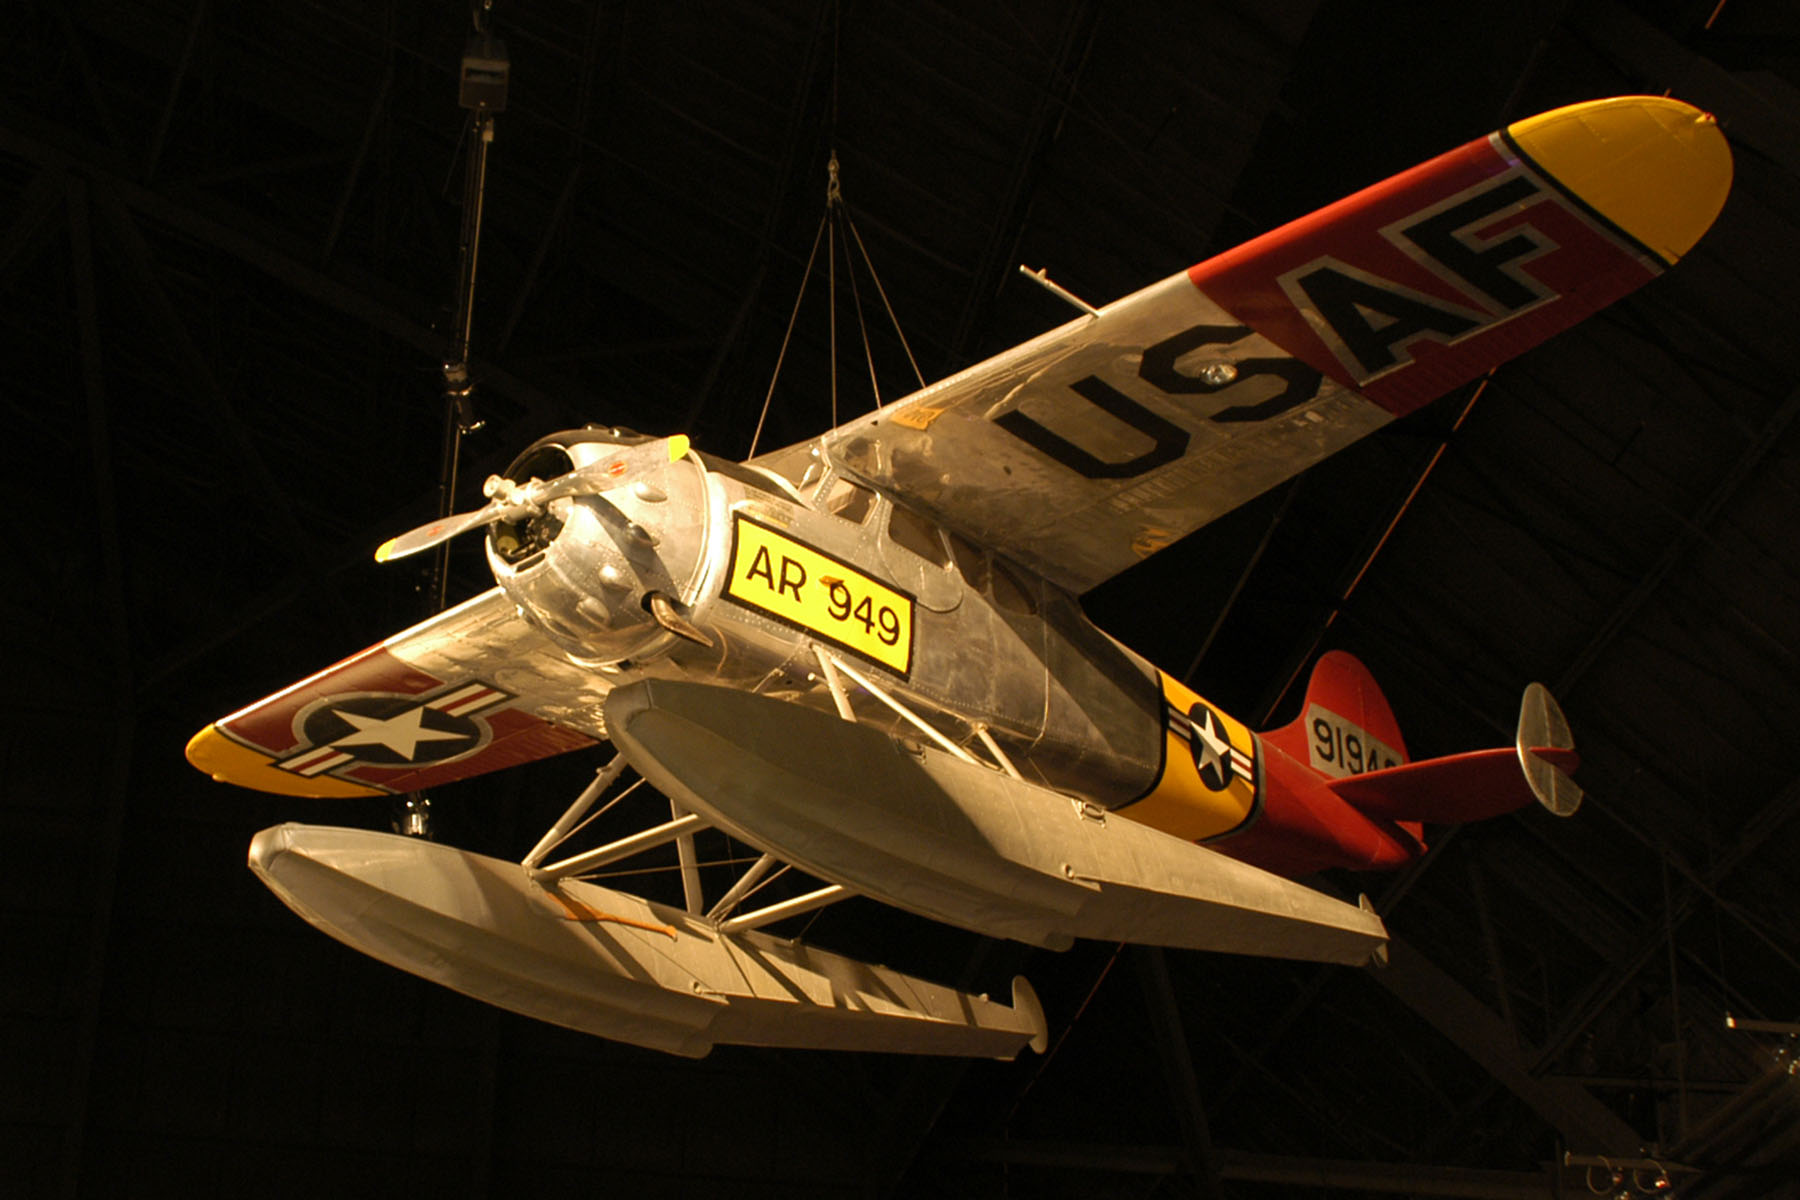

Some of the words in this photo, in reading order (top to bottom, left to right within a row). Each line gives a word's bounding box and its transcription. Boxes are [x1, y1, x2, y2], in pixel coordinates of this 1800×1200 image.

[993, 175, 1552, 479] USAF
[746, 545, 807, 603] AR
[828, 582, 900, 646] 949
[1313, 717, 1397, 775] 9194
